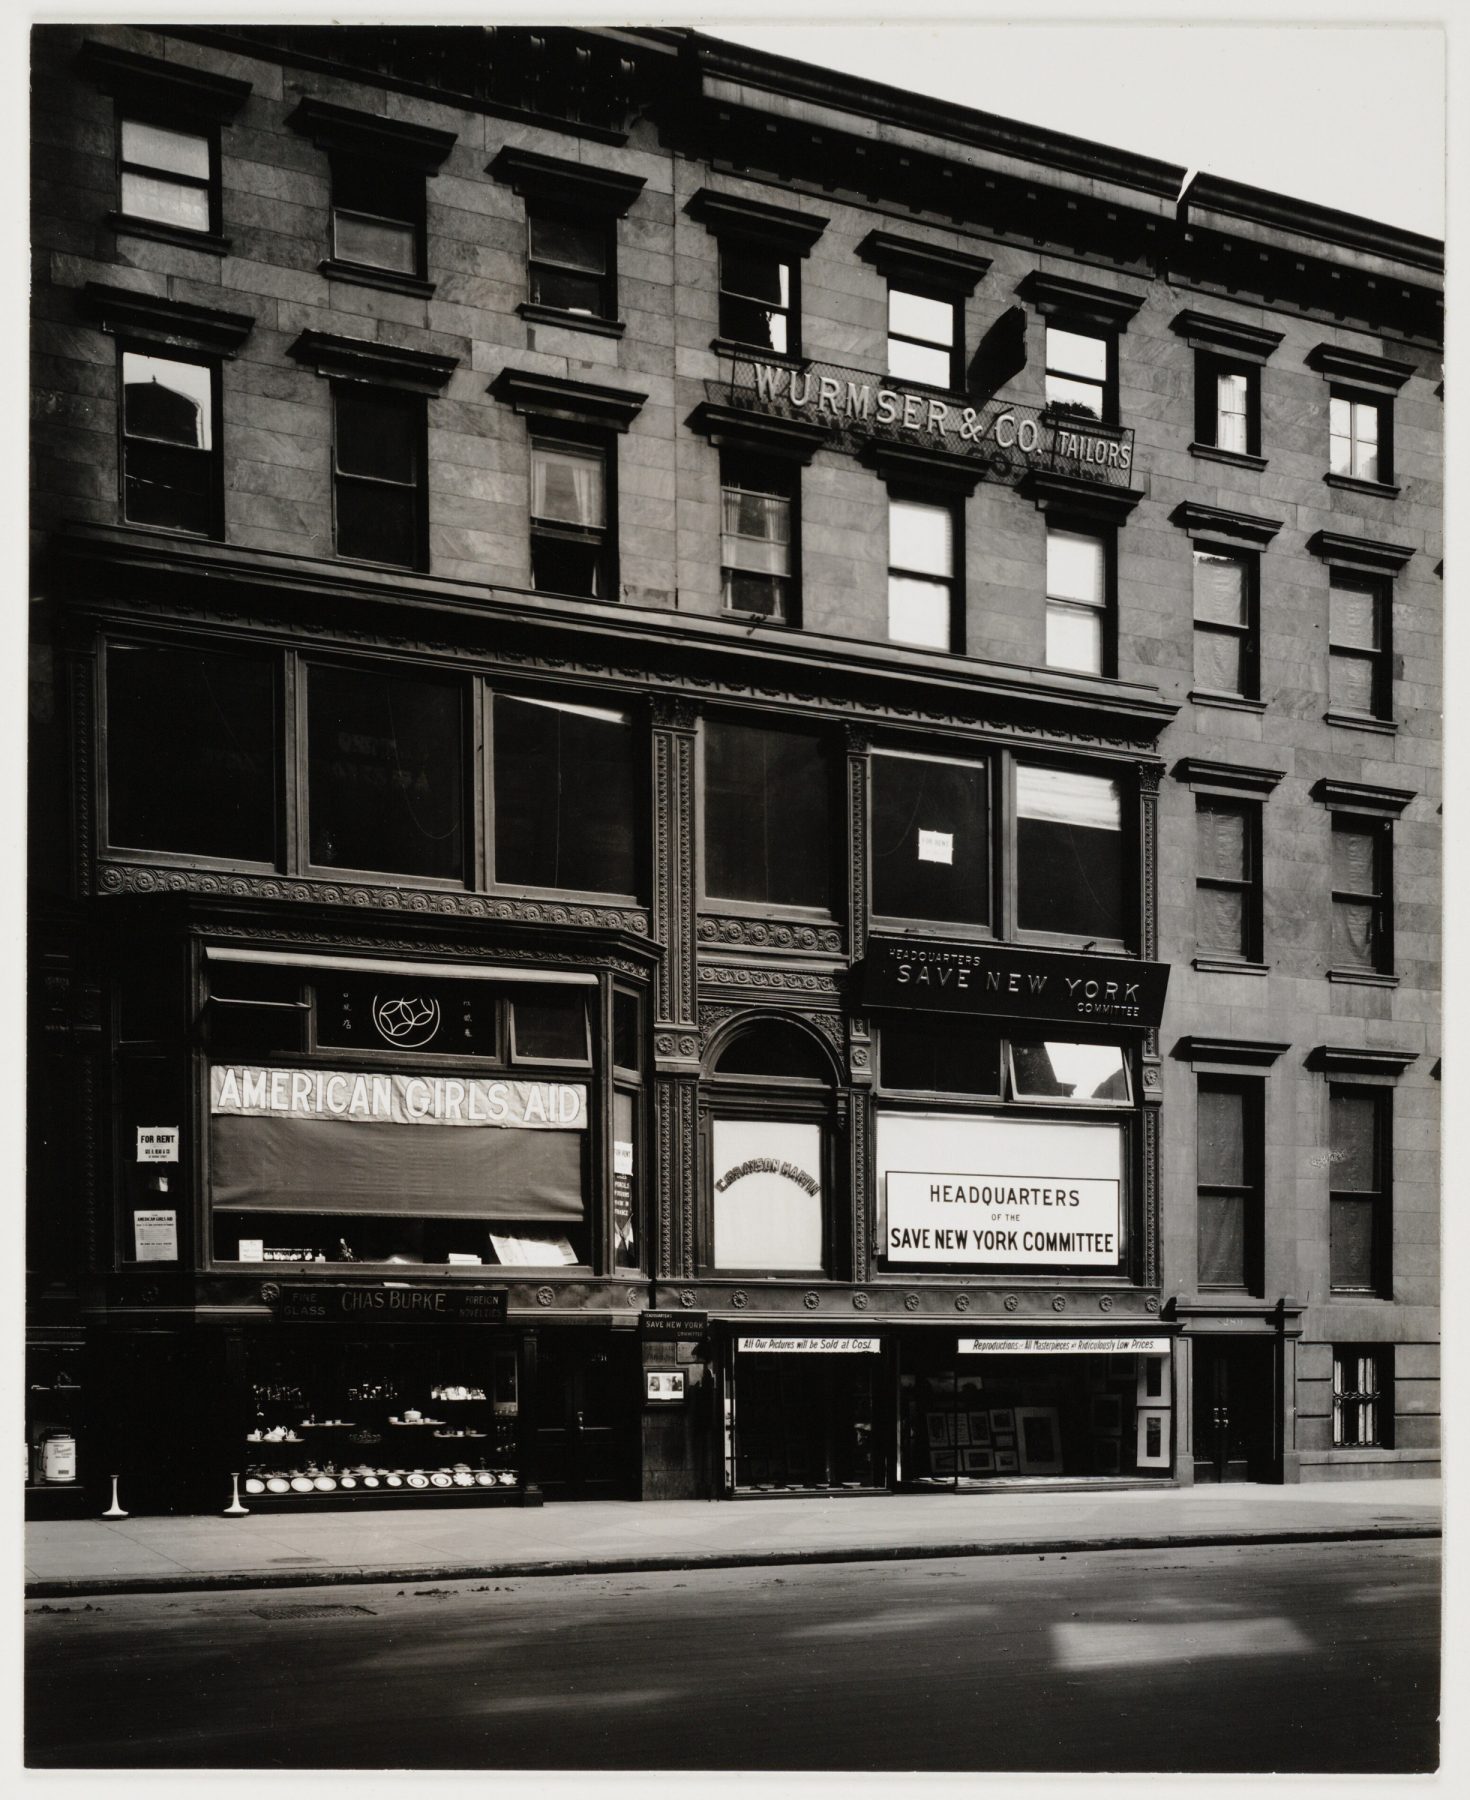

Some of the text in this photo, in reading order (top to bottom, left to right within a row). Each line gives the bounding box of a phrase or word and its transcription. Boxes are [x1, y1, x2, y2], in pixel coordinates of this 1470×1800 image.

[753, 363, 1131, 469] WURMSER & CO. TAILORS
[889, 948, 981, 967] HEADQUARTERS
[896, 964, 1140, 1003] SAVE NEW YORK
[1077, 1002, 1140, 1018] COMMITTEE
[217, 1067, 582, 1123] AMERICAN GIRLS AID
[140, 1134, 175, 1144] FOR RENT
[779, 1161, 822, 1198] MARTIN
[930, 1184, 1080, 1207] HEADQUARTERS
[991, 1213, 1021, 1222] OF THE
[891, 1228, 1114, 1253] SAVE NEW YORK COMMITTEE
[292, 1290, 499, 1313] FINE CHAS BURKE FOREIGN
[284, 1306, 502, 1319] GLASS NOVELTIES
[645, 1320, 704, 1329] SAVE NEW YORK
[743, 1339, 753, 1349] All
[755, 1339, 768, 1349] Our
[769, 1340, 794, 1349] Pictures
[796, 1340, 808, 1349] will
[809, 1340, 818, 1349] be
[820, 1340, 839, 1350] Sold
[841, 1340, 849, 1349] at
[1078, 1340, 1116, 1351] Ridiculously
[1117, 1340, 1129, 1350] Low
